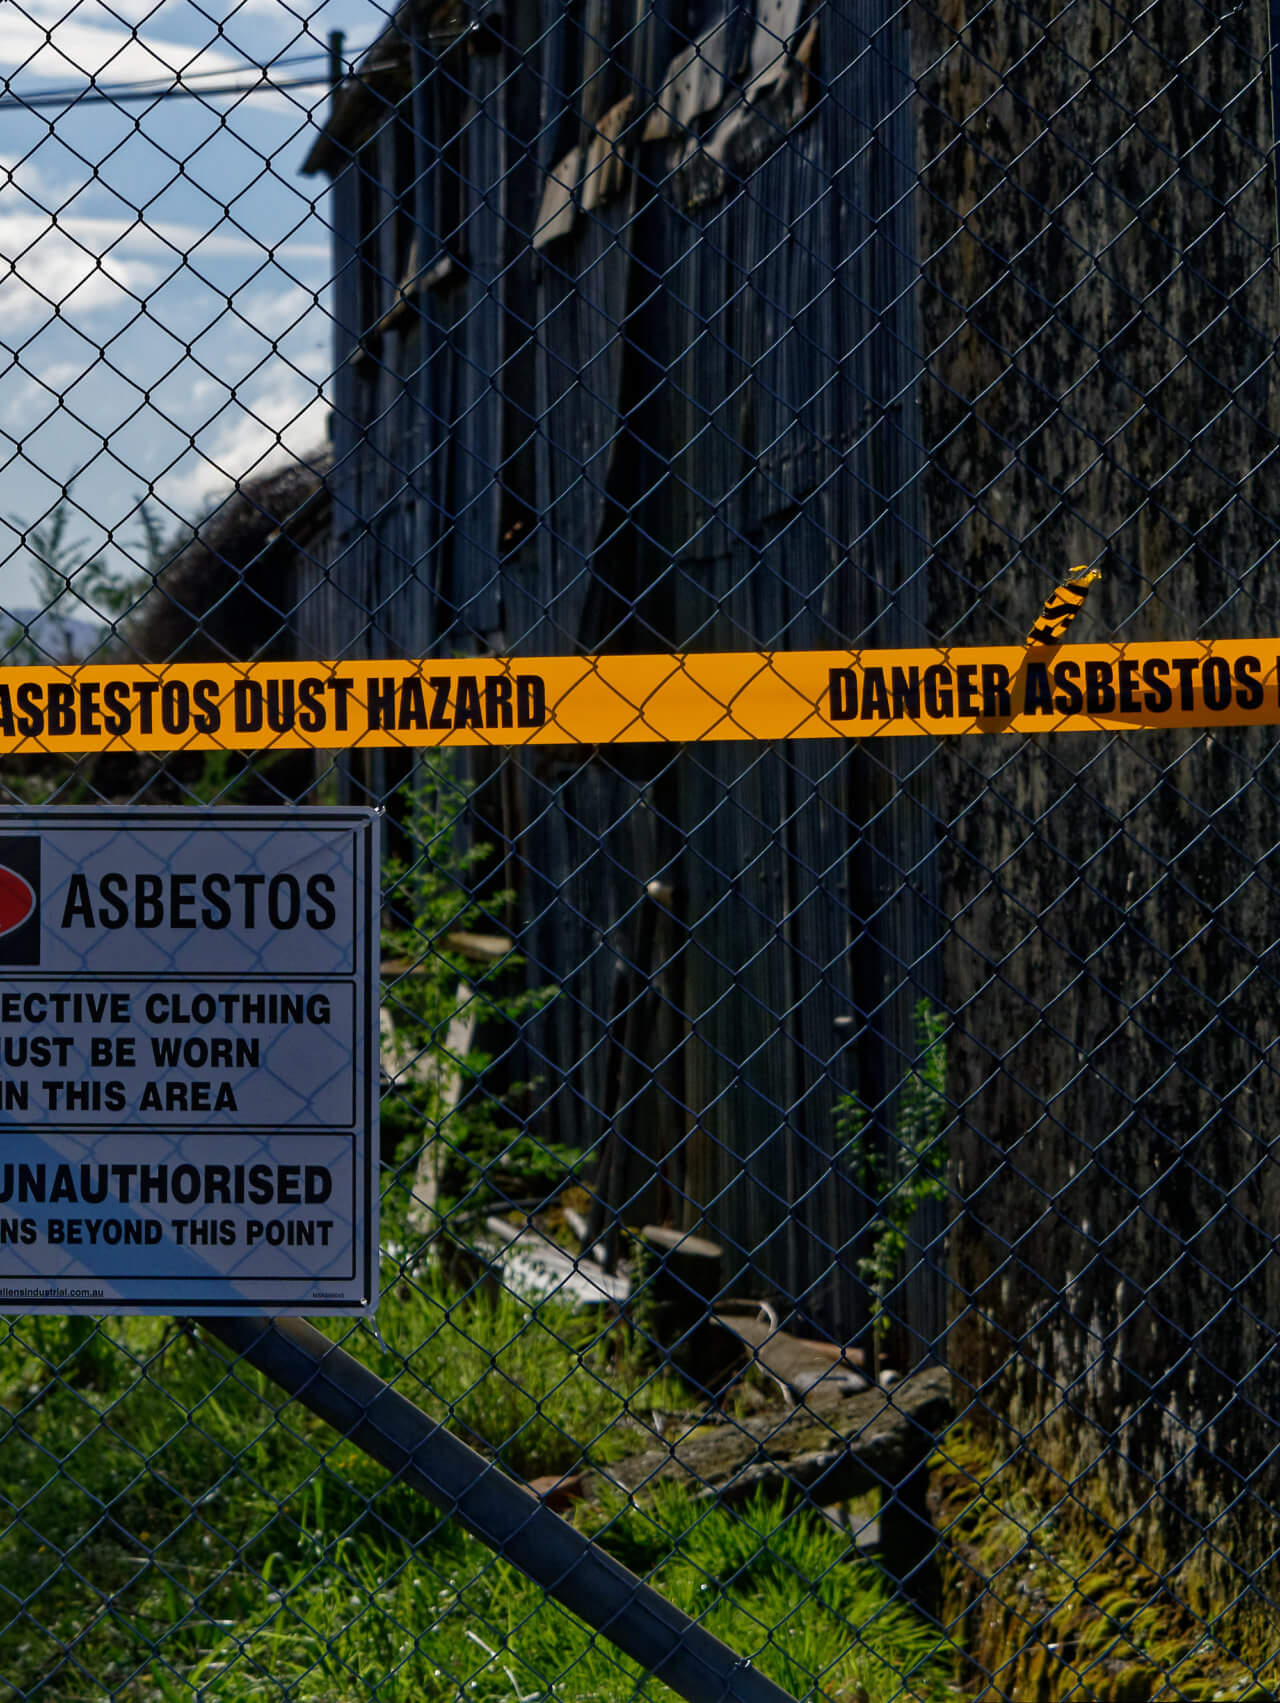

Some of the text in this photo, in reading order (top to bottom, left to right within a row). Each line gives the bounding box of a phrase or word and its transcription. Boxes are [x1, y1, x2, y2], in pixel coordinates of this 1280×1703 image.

[234, 678, 354, 733] DUST
[367, 674, 546, 730] HAZARD
[829, 664, 1011, 720] DANGER
[1023, 656, 1265, 716] ASBESTOS
[61, 873, 337, 930] ASBESTOS
[145, 993, 331, 1025] CLOTHING
[91, 1037, 136, 1067] BE
[151, 1037, 260, 1068] WORN
[42, 1081, 126, 1112] THIS
[139, 1081, 239, 1112] AREA
[47, 1219, 162, 1246] BEYOND
[172, 1219, 236, 1246] THIS
[246, 1220, 333, 1246] POINT
